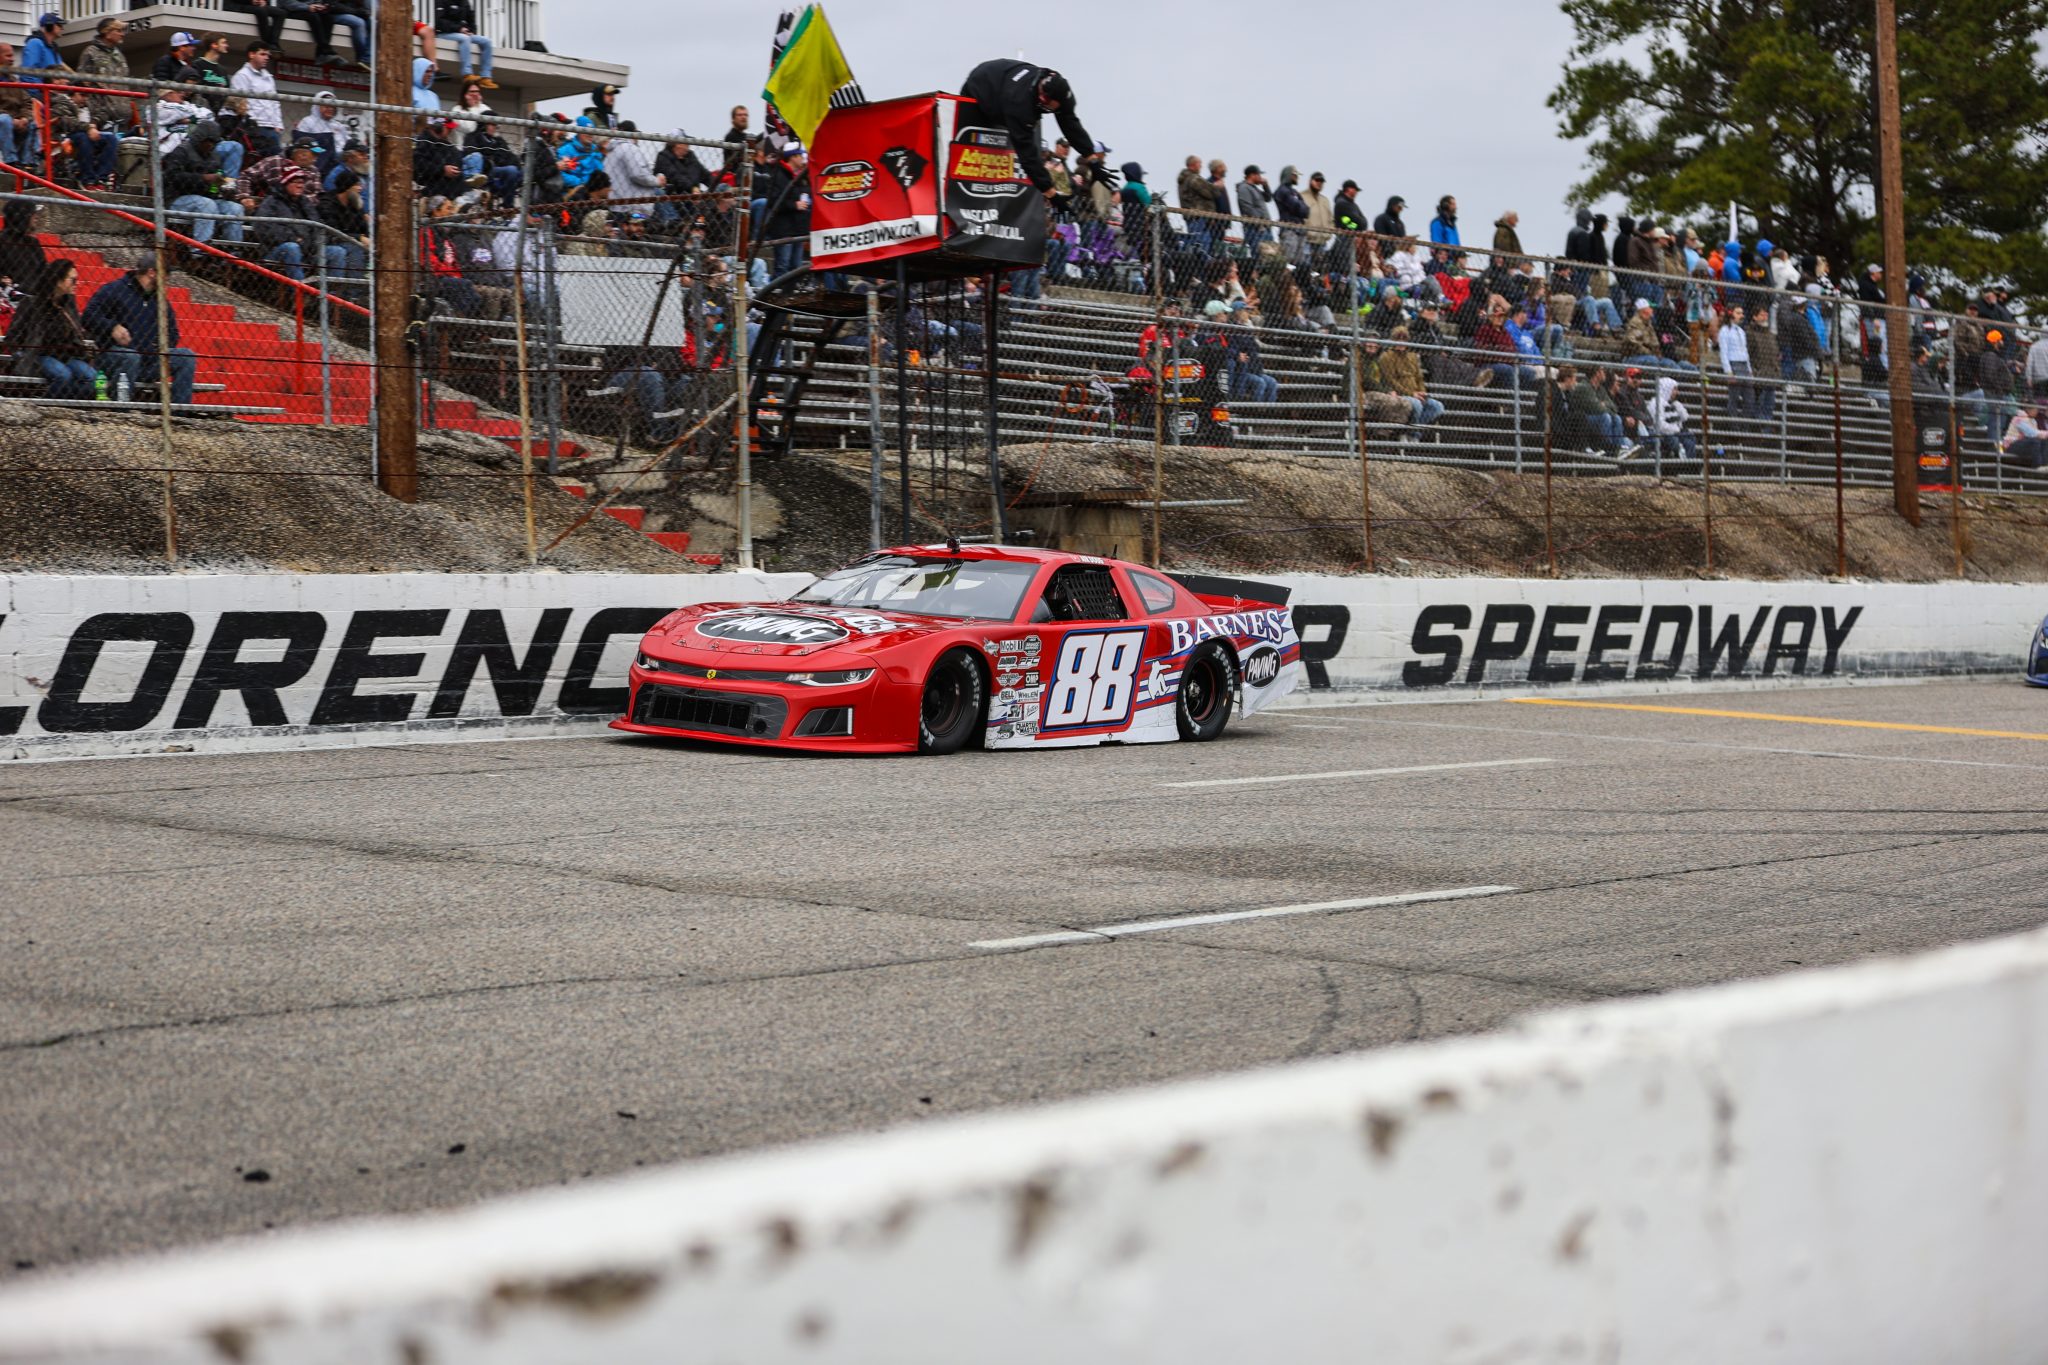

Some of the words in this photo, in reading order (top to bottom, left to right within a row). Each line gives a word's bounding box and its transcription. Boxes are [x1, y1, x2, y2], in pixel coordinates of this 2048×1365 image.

[954, 163, 980, 177] Auto
[980, 165, 1010, 179] Parts
[959, 148, 1010, 167] Advance
[710, 614, 838, 641] PAVING
[1167, 608, 1284, 656] BARNES
[1402, 604, 1864, 688] SPEEDWAY
[1044, 630, 1145, 727] 88
[1247, 652, 1277, 681] PAVING
[1000, 690, 1014, 699] BELL
